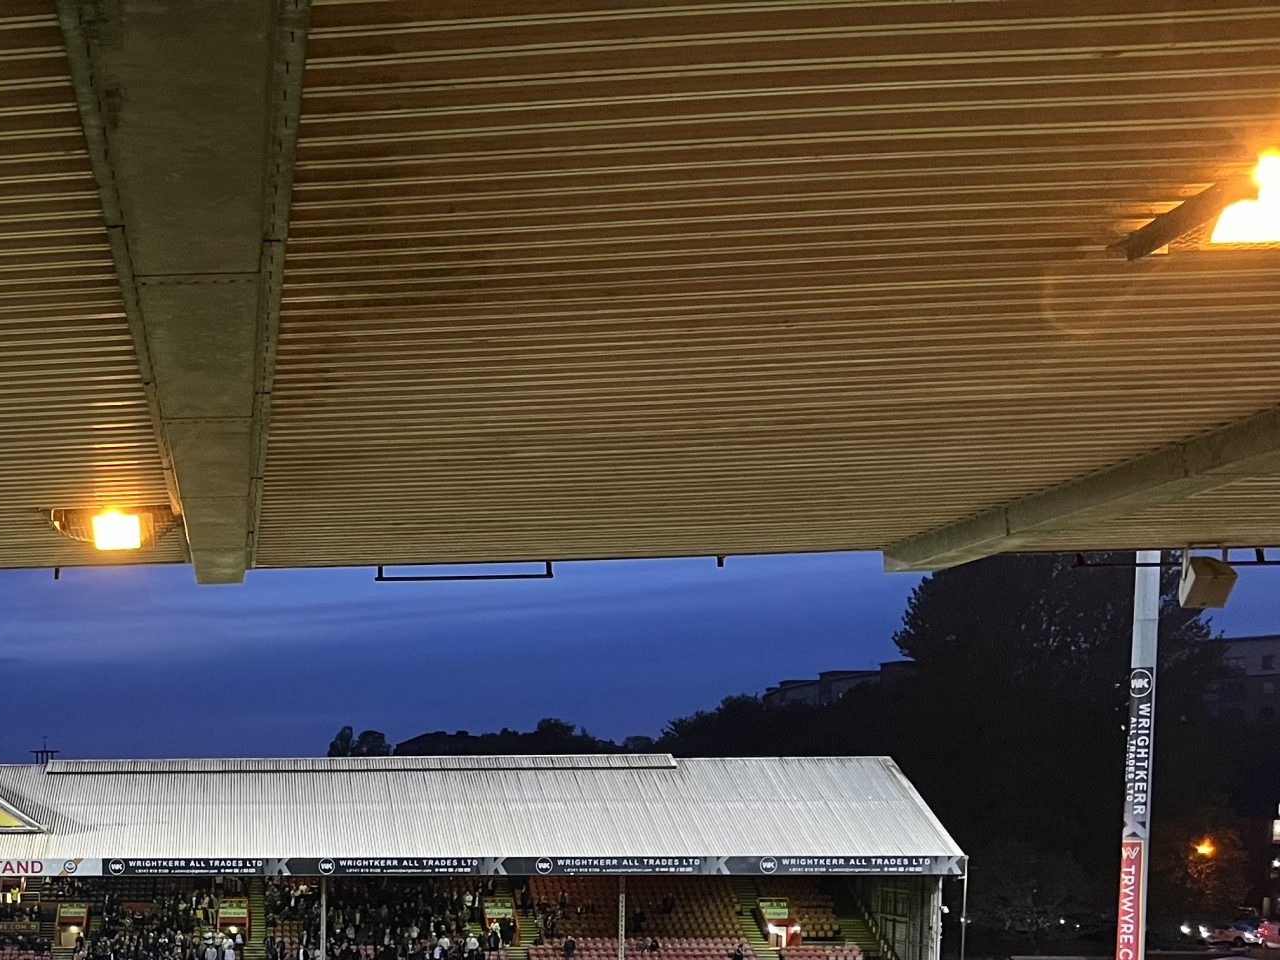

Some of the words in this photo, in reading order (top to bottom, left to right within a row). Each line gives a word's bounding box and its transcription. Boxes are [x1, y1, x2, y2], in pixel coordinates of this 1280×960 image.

[1128, 739, 1136, 780] TRADES
[1133, 702, 1151, 815] WRIGHTKERR
[1126, 782, 1134, 802] LTD
